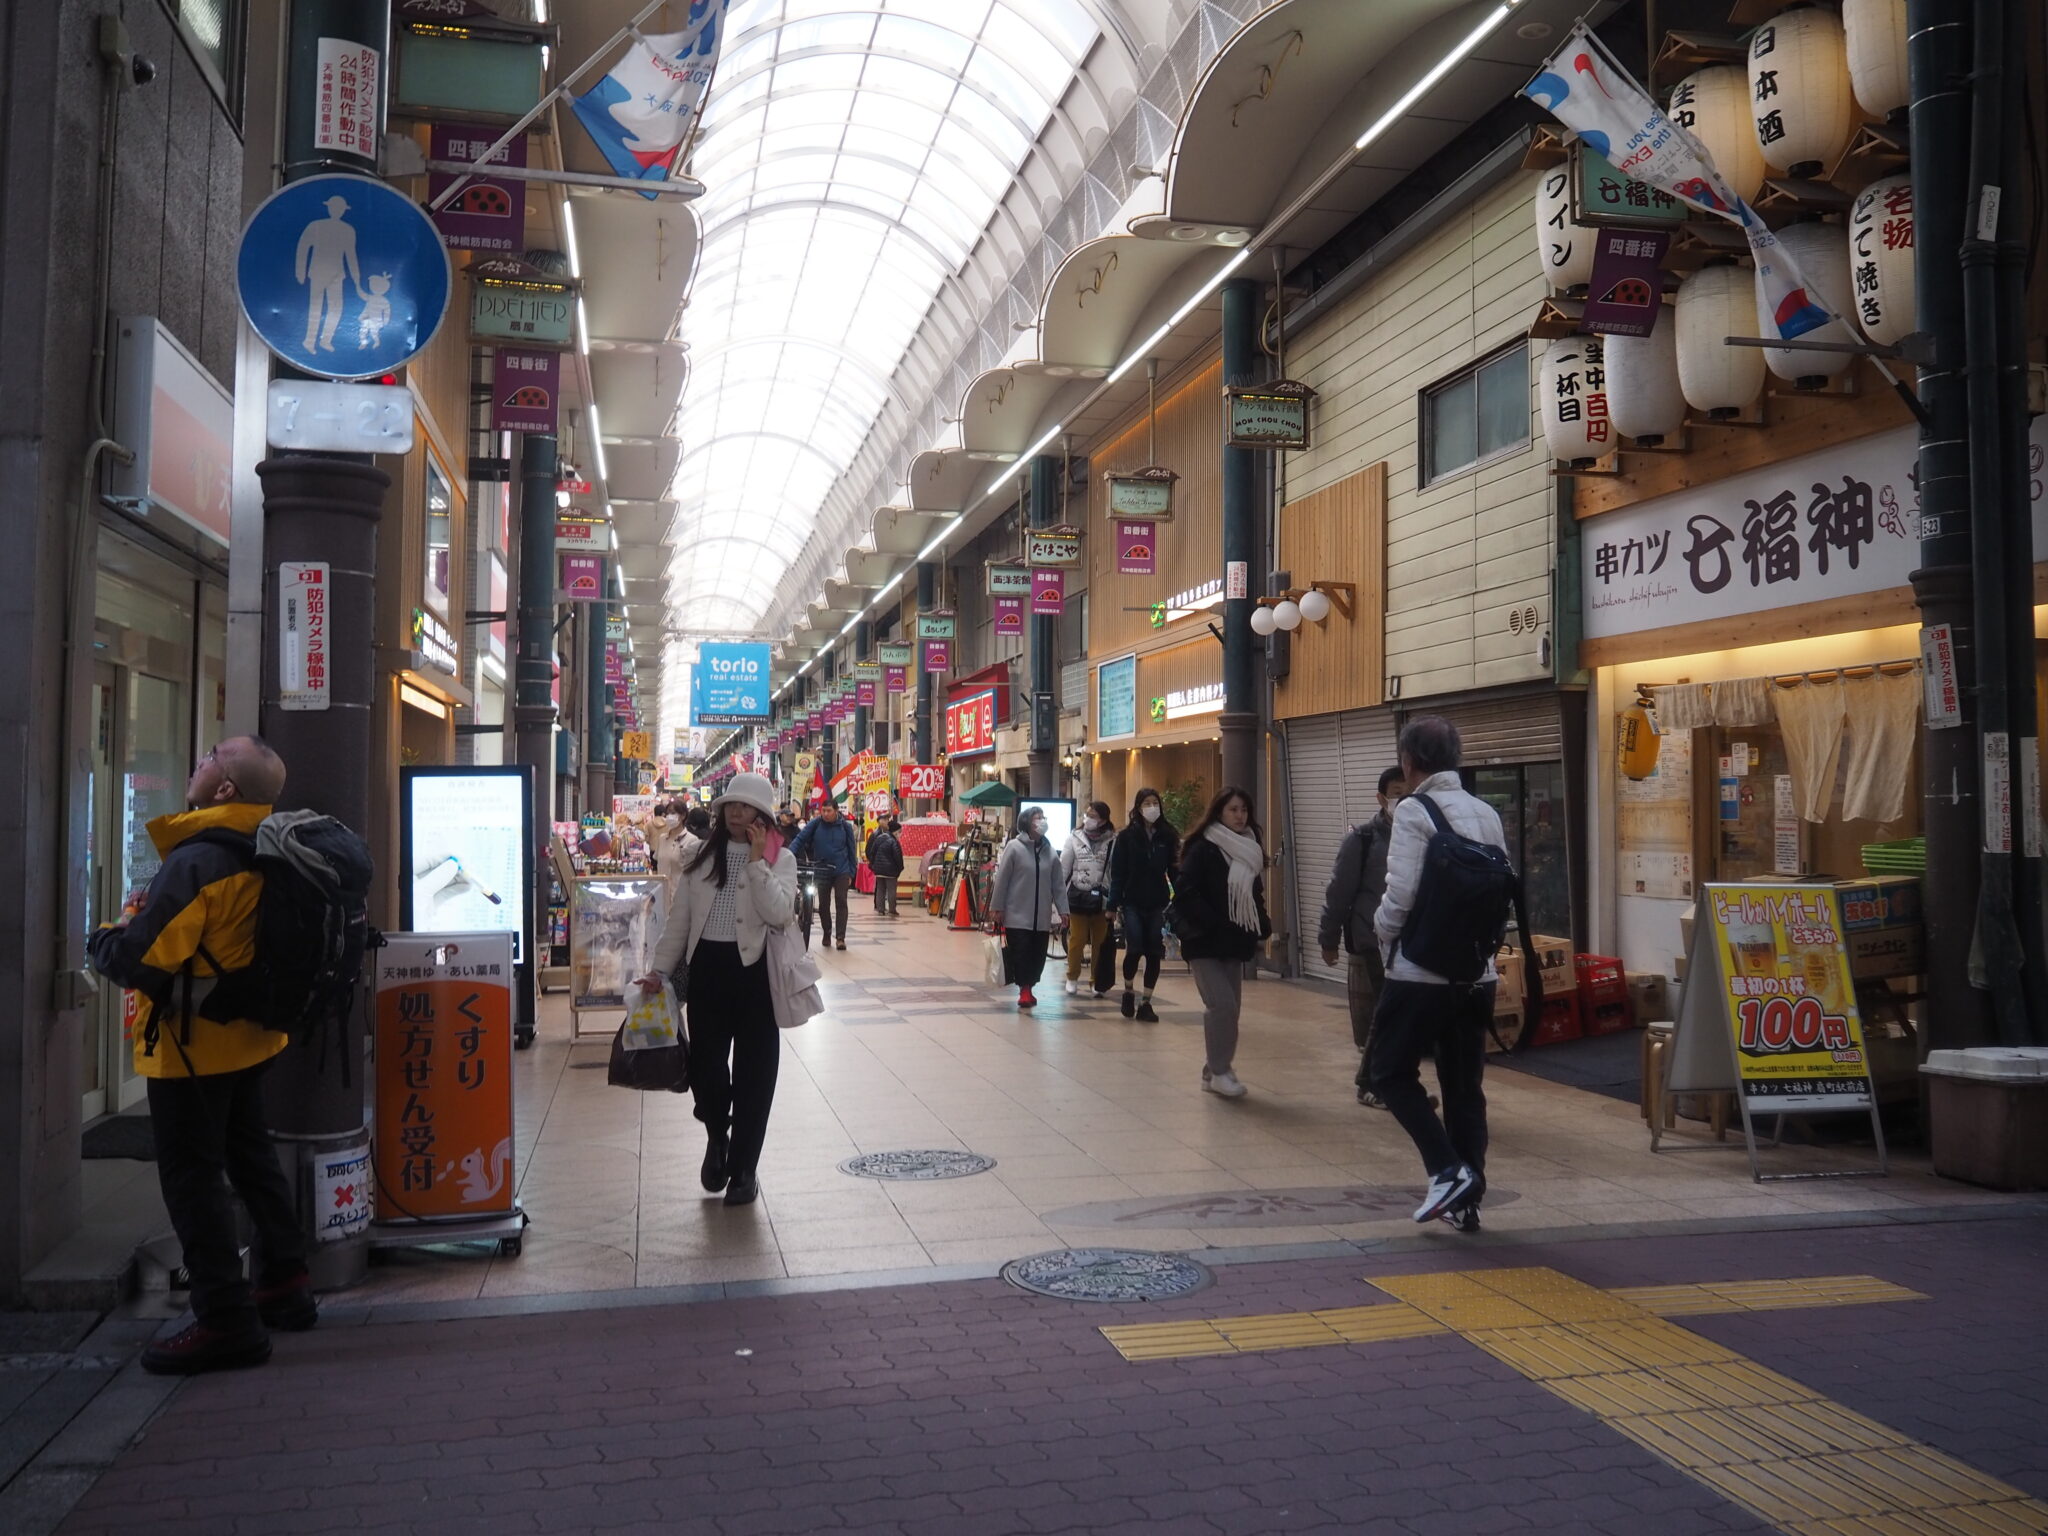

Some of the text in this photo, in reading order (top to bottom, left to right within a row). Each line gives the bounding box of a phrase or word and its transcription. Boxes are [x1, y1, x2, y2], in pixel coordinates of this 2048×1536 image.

[651, 56, 710, 86] EXPO202
[1754, 26, 1786, 147] 日本酒
[338, 54, 358, 148] 24時間作動中
[358, 49, 375, 155] 防犯カメラ設置
[643, 92, 690, 117] 大阪府
[448, 139, 510, 163] 四番街
[1598, 177, 1676, 209] 七福神
[1547, 174, 1572, 267] ワイン
[1882, 185, 1914, 250] 名物
[1608, 237, 1657, 258] 四番街
[1854, 189, 1881, 326] どて焼き
[479, 296, 567, 323] PREMIER
[506, 355, 548, 371] 四番街
[1556, 353, 1581, 423] 一杯目
[1585, 343, 1609, 443] 生中百円
[1257, 416, 1278, 424] CHOU
[1281, 419, 1302, 431] CHOU
[1123, 526, 1149, 536] 四番街
[1682, 475, 1874, 594] 七福神
[1923, 518, 1939, 535] E-23
[1032, 542, 1078, 558] たばこや
[1595, 529, 1671, 584] 串カツ
[306, 588, 325, 691] 防犯カメラ稼働中
[710, 656, 758, 673] torio
[710, 673, 758, 682] real estate
[1937, 641, 1956, 714] 防犯カメラ稼働中
[1714, 892, 1831, 926] ビールかハイボール
[1791, 927, 1838, 945] どちらか
[383, 964, 501, 980] 天神橋ゆあい薬局
[1730, 976, 1806, 997] 最初の1杯
[1738, 997, 1851, 1051] 100円
[455, 993, 488, 1090] くすり
[398, 992, 436, 1193] 処方せん受付
[1750, 1082, 1778, 1095] 串カツ
[1782, 1081, 1813, 1094] 七福神
